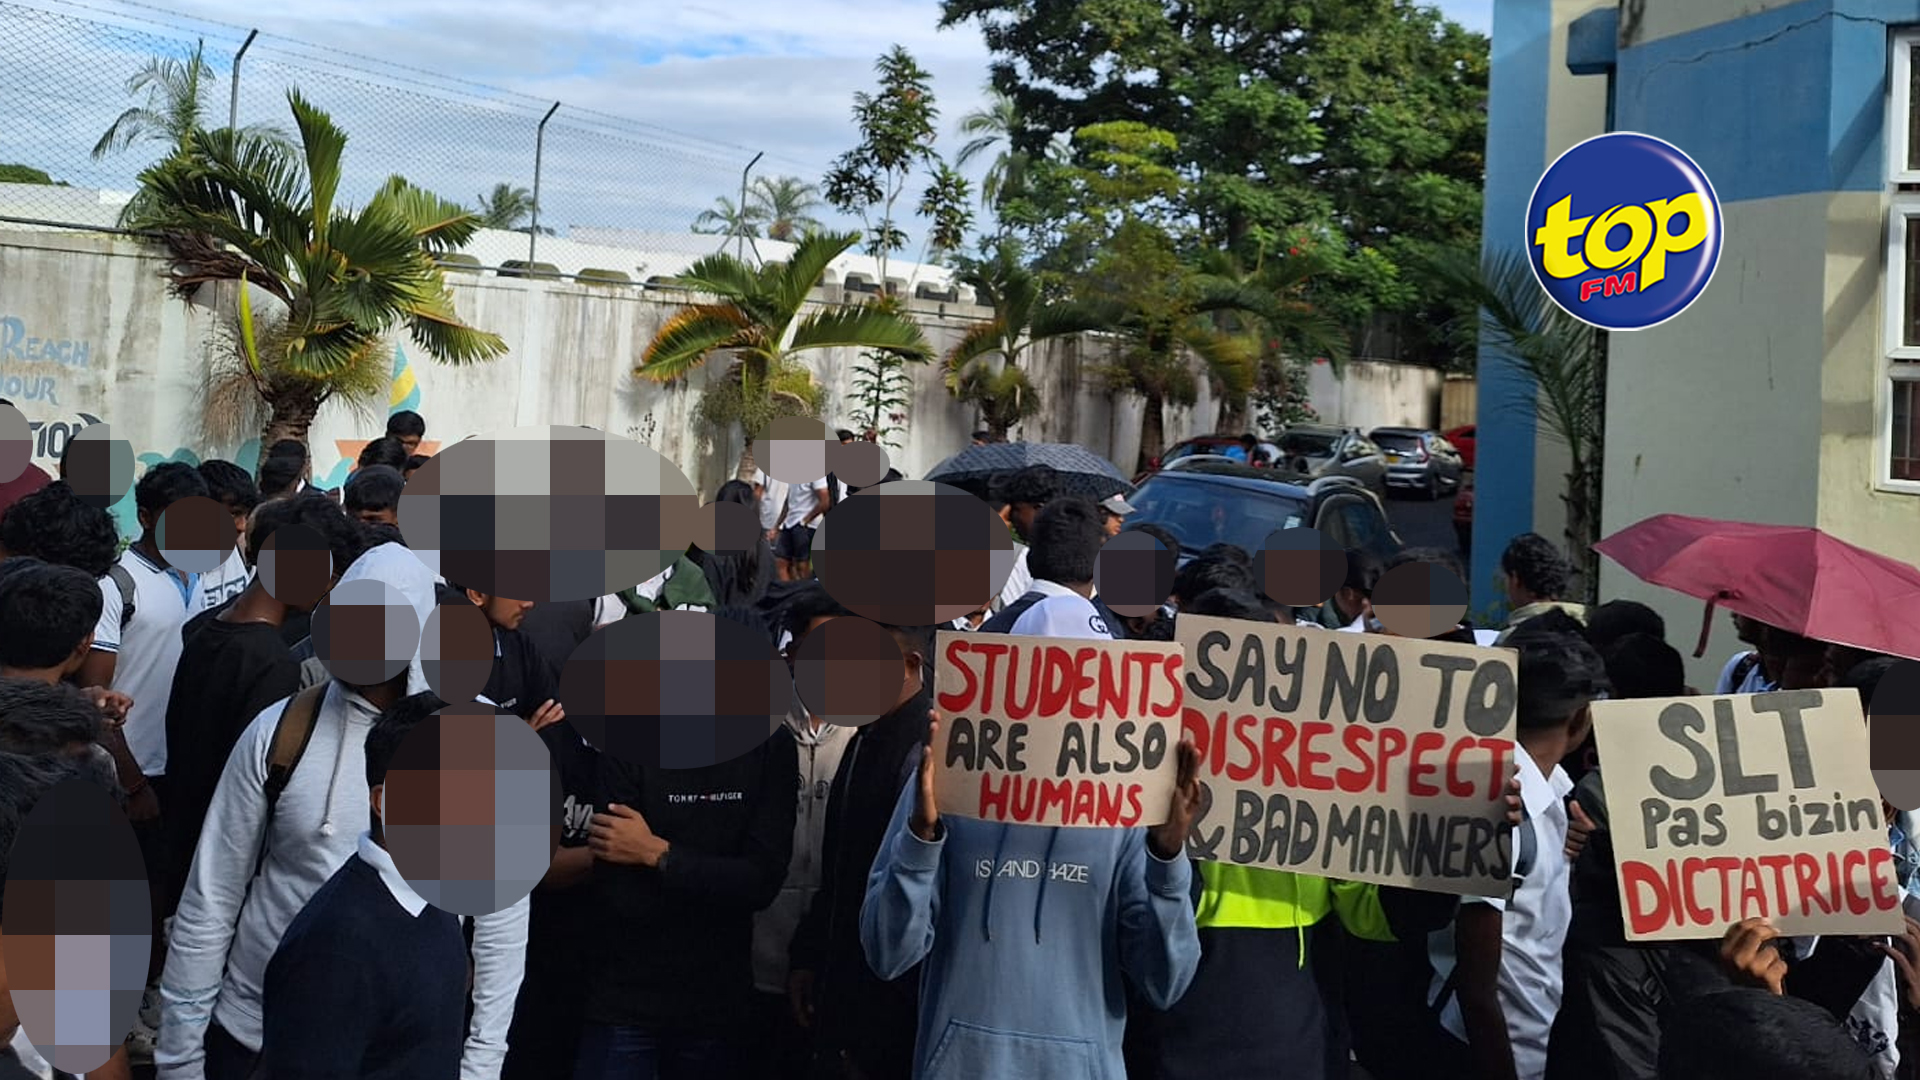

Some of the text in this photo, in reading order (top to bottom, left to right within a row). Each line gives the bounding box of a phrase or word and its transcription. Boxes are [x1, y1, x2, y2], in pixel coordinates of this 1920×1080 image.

[0, 375, 59, 406] OUR
[937, 639, 1184, 720] STUDENTS
[1184, 630, 1517, 736] SAY NO TO
[945, 717, 1167, 777] ARE ALSO
[1181, 706, 1516, 801] DISRESPECT
[1649, 689, 1824, 800] SLT
[978, 771, 1143, 827] HUMANS
[1230, 789, 1319, 866] BAD
[1321, 803, 1513, 880] MANNERS
[1755, 791, 1879, 840] bizin
[1620, 847, 1898, 935] DICTATRICE
